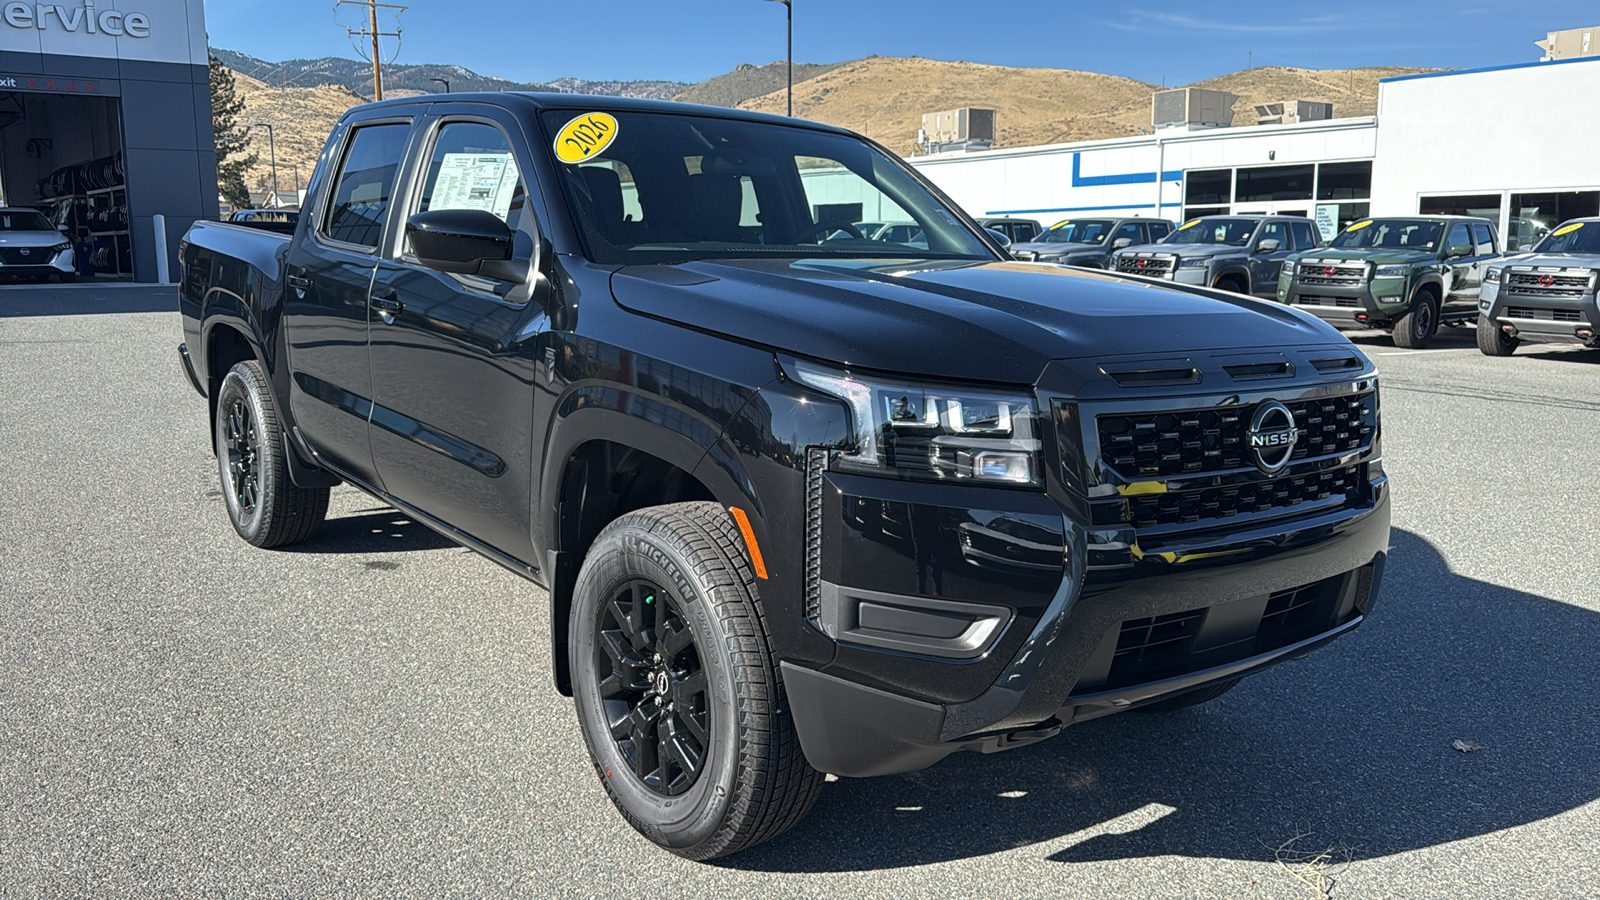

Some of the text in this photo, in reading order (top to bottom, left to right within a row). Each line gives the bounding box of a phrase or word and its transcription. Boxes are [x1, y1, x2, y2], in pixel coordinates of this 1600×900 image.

[0, 0, 150, 38] ervice
[565, 115, 609, 155] 2026
[639, 541, 694, 600] MICHELIN
